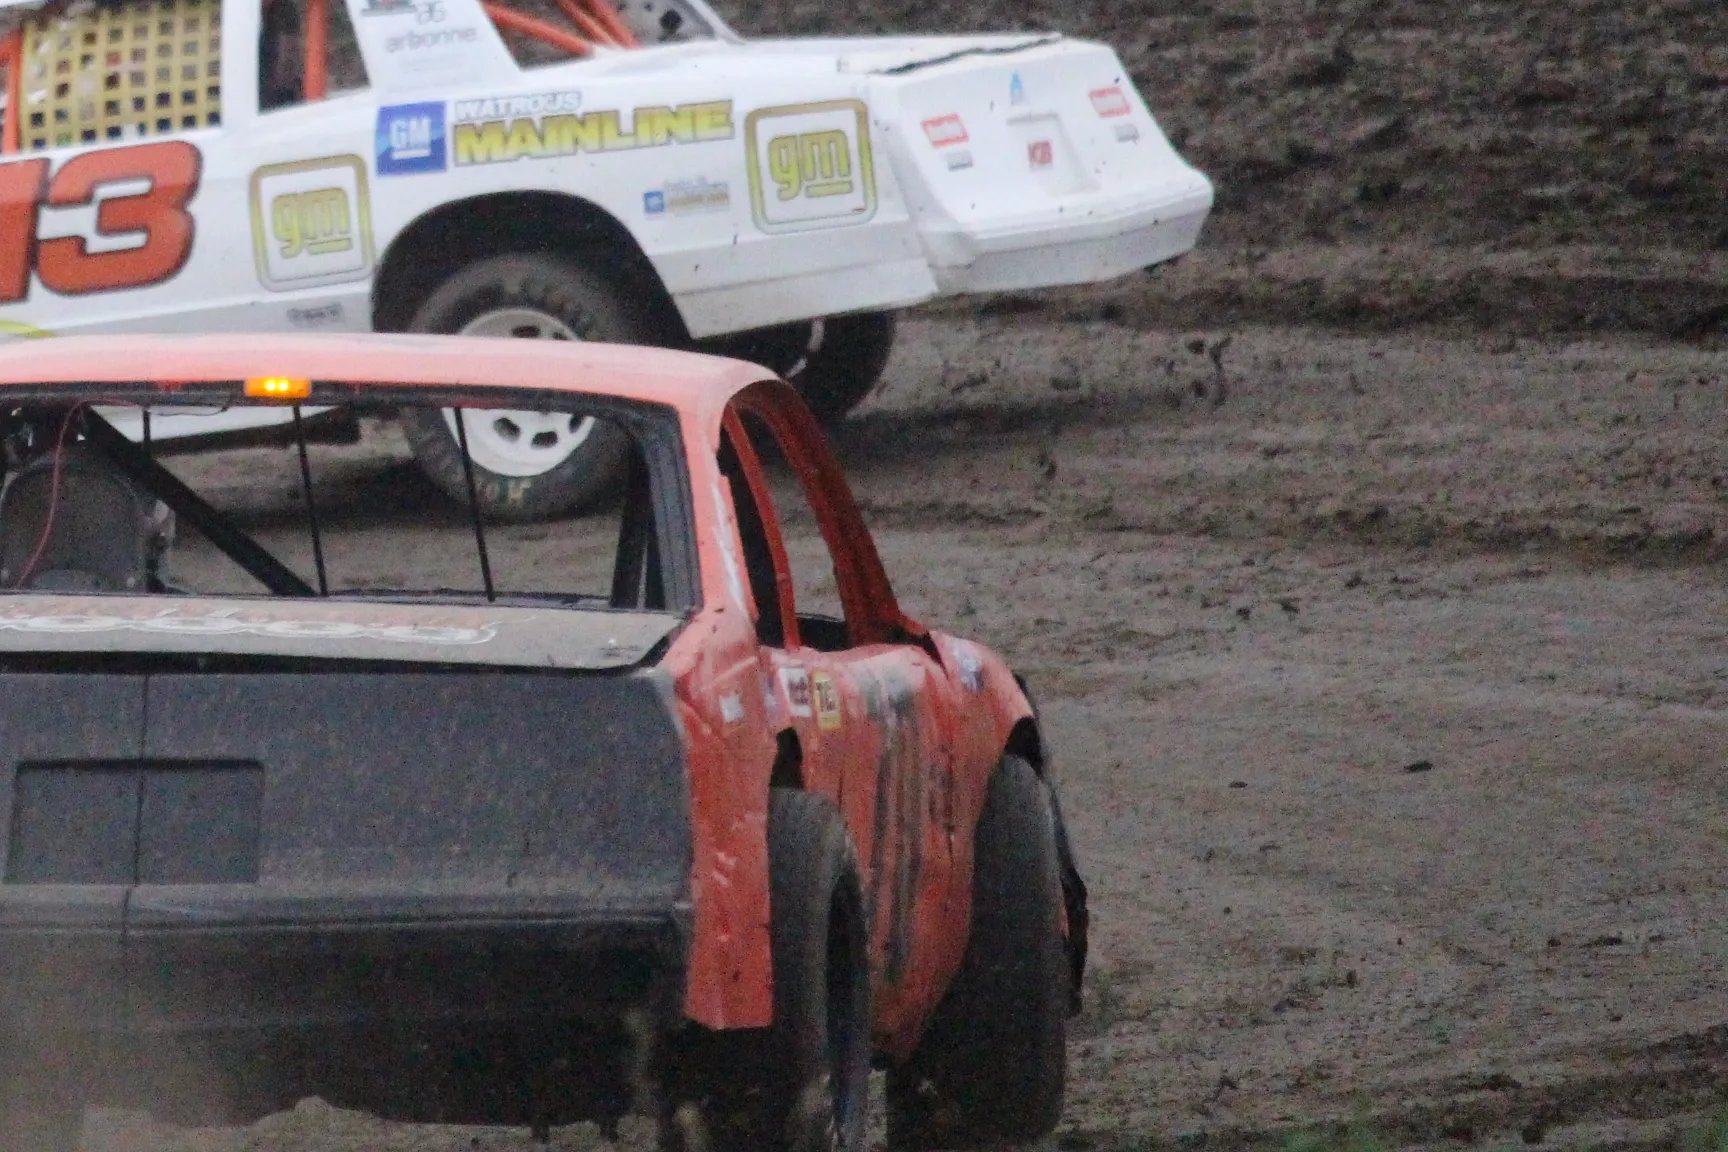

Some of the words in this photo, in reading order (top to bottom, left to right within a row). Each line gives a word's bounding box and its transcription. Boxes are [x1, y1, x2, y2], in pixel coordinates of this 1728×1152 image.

[389, 116, 432, 150] GM
[453, 99, 735, 167] MAINLINE
[454, 91, 582, 122] WATROUS
[767, 128, 853, 202] gm
[271, 185, 353, 260] gm
